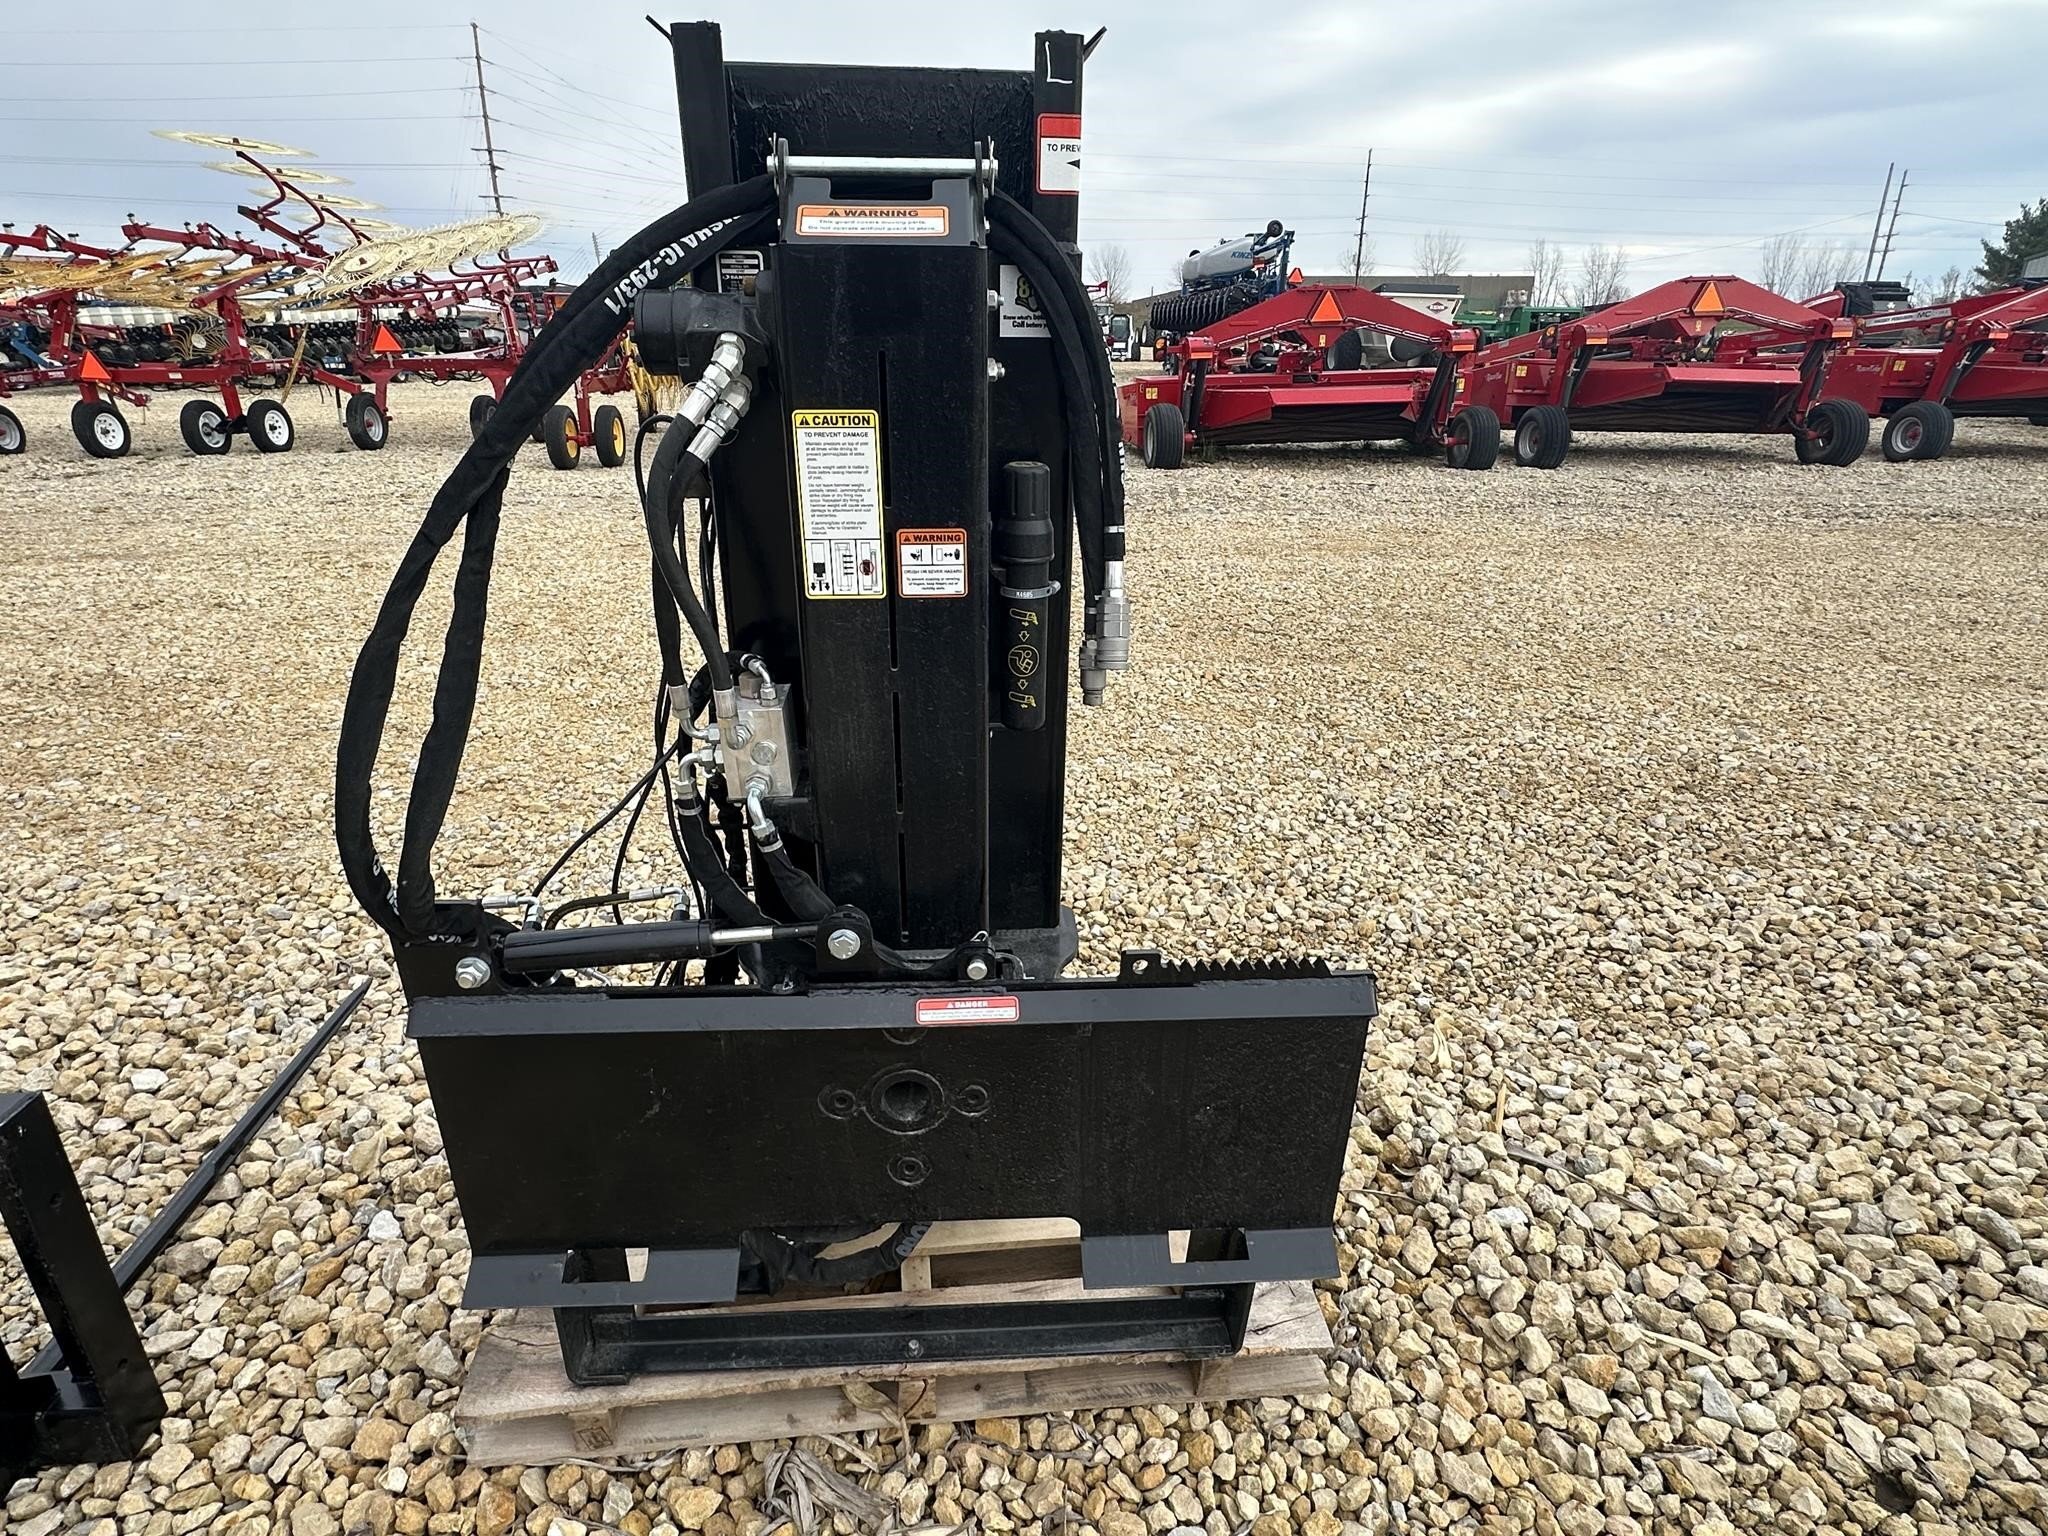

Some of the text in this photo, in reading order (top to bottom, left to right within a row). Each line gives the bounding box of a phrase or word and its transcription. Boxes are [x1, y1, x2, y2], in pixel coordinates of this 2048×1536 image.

[1047, 143, 1058, 152] TO
[604, 243, 685, 315] IC-293/1
[812, 415, 871, 426] CAUTION
[912, 534, 962, 542] WARNING
